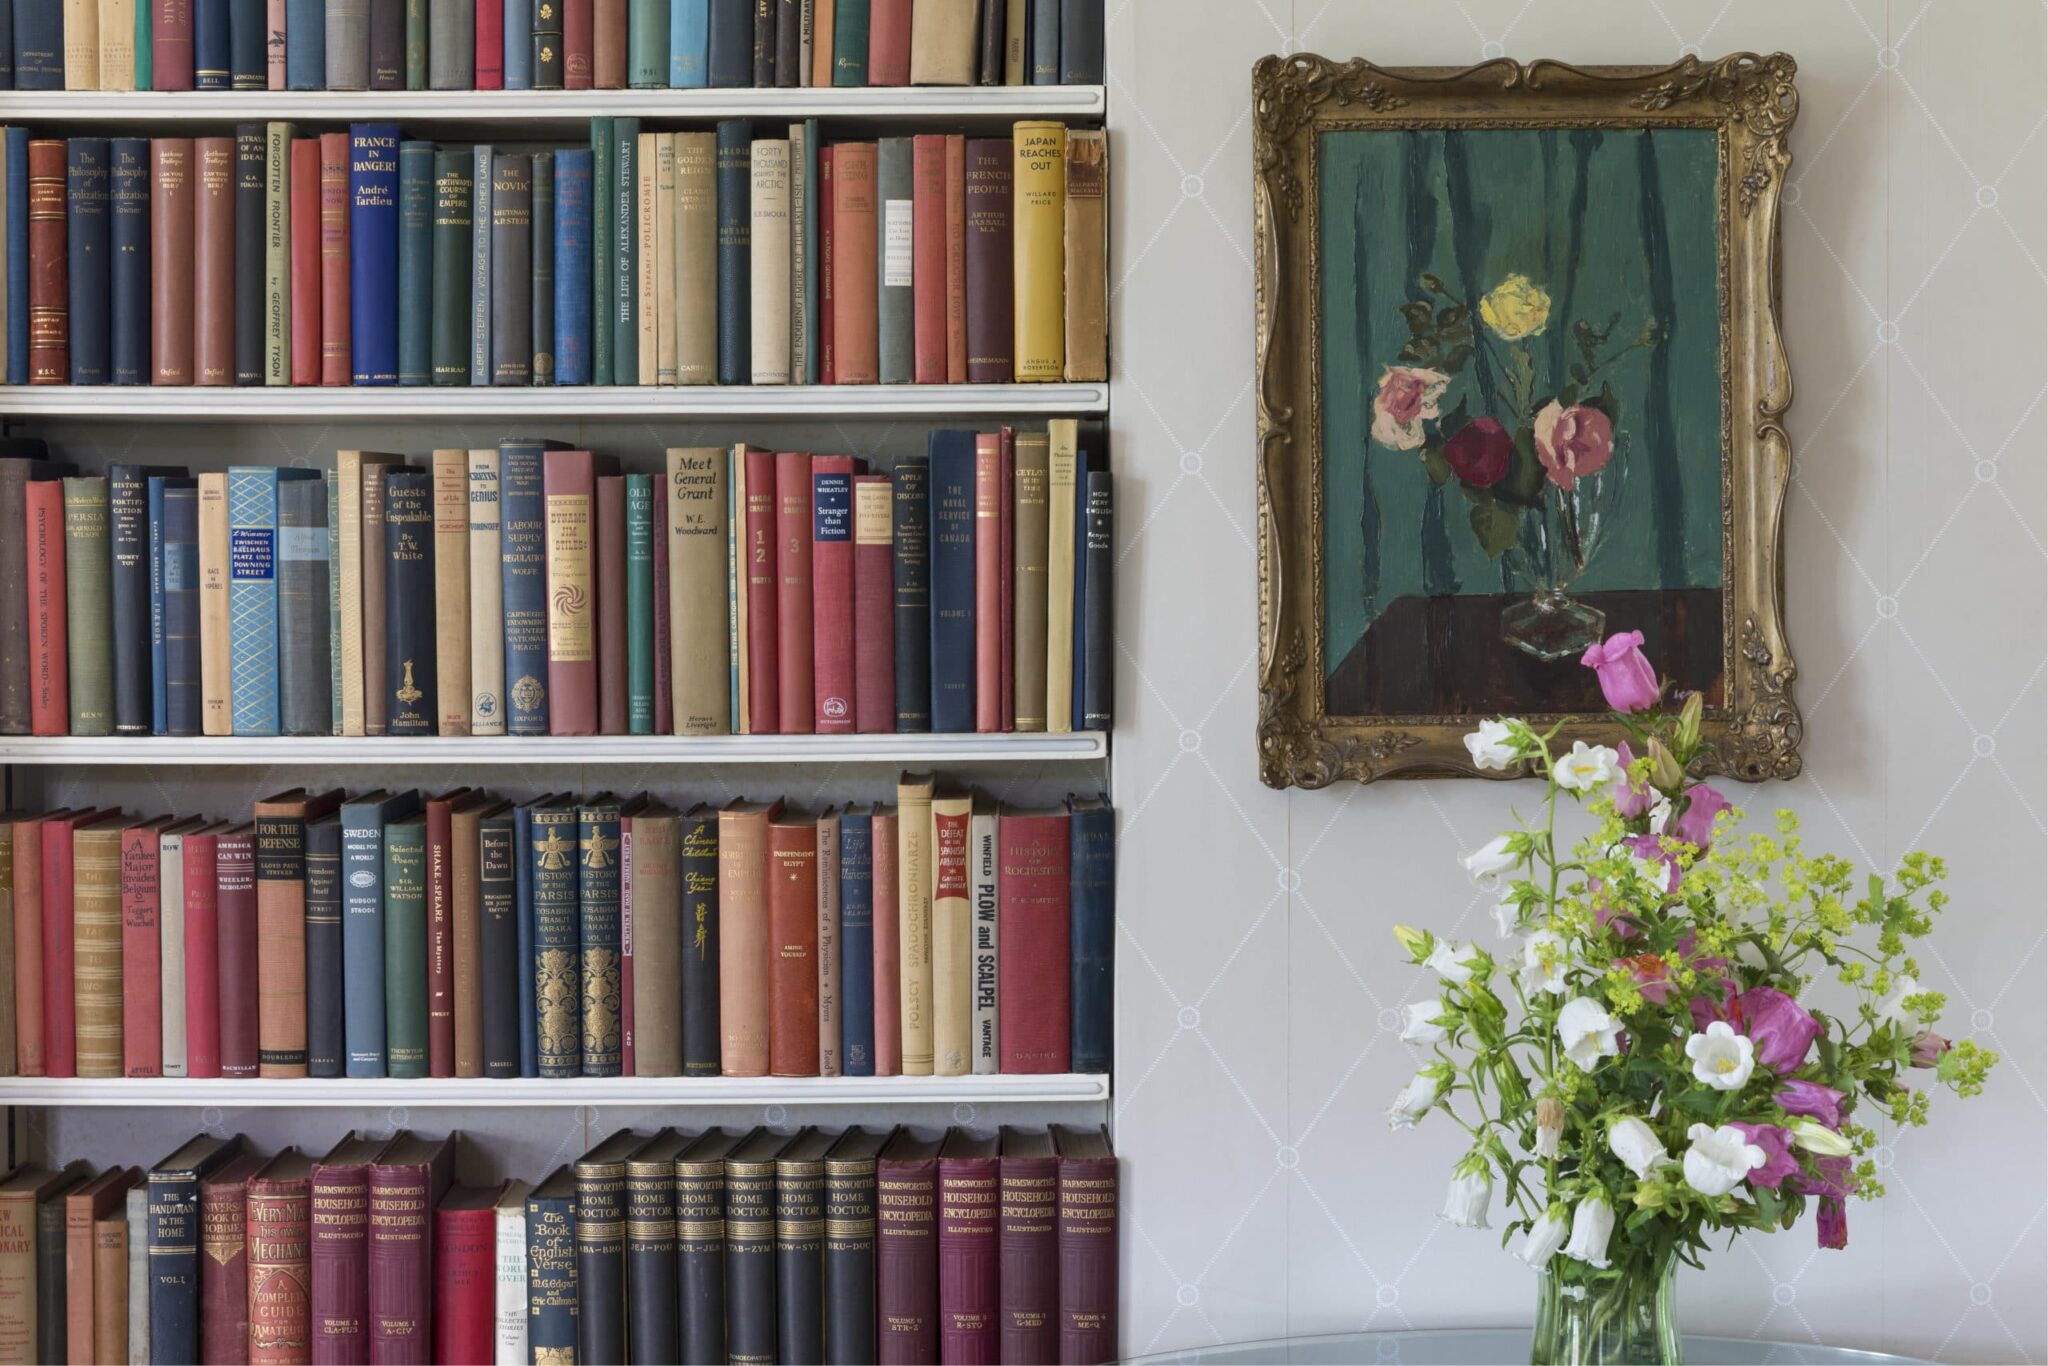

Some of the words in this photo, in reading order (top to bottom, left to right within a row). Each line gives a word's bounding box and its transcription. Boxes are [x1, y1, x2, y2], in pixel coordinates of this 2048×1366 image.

[803, 0, 811, 34] MILITAR
[354, 138, 395, 148] FRANCE
[1025, 138, 1056, 146] JAPAN
[757, 147, 782, 157] FORTY
[80, 153, 94, 164] The
[121, 153, 135, 164] The
[622, 141, 630, 185] STEWART
[354, 162, 396, 172] DANGER!
[753, 159, 787, 169] THOUSAND
[1031, 162, 1051, 170] OUT
[967, 172, 1011, 180] FRENCH
[83, 178, 92, 188] of
[124, 178, 131, 188] of
[756, 180, 783, 189] ARCTIC
[358, 186, 388, 195] André
[968, 185, 1007, 193] PEOPLE
[356, 196, 392, 206] Tardieu
[479, 235, 486, 248] TO
[622, 258, 628, 270] OF
[272, 277, 278, 286] by
[680, 458, 712, 470] Meet
[674, 472, 716, 484] General
[389, 486, 426, 497] Guests
[471, 492, 497, 501] GENIUS
[630, 488, 650, 497] OLD
[677, 487, 712, 500] Grant
[393, 501, 402, 509] of
[409, 501, 421, 509] the
[630, 501, 650, 510] AGE
[386, 511, 431, 522] Unspeakable
[819, 507, 848, 516] Stranger
[676, 527, 717, 535] Woodward
[402, 534, 412, 543] By
[508, 534, 542, 542] SUPPLY
[757, 530, 763, 544] 1
[790, 539, 800, 551] 3
[756, 550, 766, 562] 2
[260, 824, 276, 834] FOR
[280, 824, 299, 834] THE
[344, 830, 380, 838] SWEDEN
[696, 825, 703, 834] A
[941, 830, 963, 838] DEFEAT
[684, 835, 716, 845] Chinese
[822, 828, 832, 846] The
[132, 839, 142, 850] A
[260, 838, 300, 848] DEFENSE
[484, 840, 508, 848] Before
[846, 839, 864, 851] Life
[124, 850, 155, 860] Yankee
[983, 835, 992, 876] WINFIELD
[125, 862, 153, 872] Major
[433, 844, 442, 922] SHAKE-SPEARE
[536, 891, 574, 899] PARSIS
[910, 831, 920, 968] SPADOCHRONIARZE
[979, 884, 994, 921] PLOW
[823, 913, 830, 924] of
[978, 927, 994, 950] and
[823, 936, 832, 975] Physician
[978, 955, 994, 1011] SCALPEL
[823, 996, 832, 1022] Myers
[910, 980, 919, 1029] POLSCY
[982, 1019, 991, 1057] VANTAGE
[824, 1050, 832, 1070] Reed
[1003, 1177, 1055, 1186] HARMSWORTH'S
[1063, 1178, 1114, 1188] HARMSWORTH'S
[583, 1196, 613, 1205] HOME
[634, 1194, 665, 1203] HOME
[682, 1194, 713, 1203] HOME
[732, 1195, 762, 1203] HOME
[782, 1194, 812, 1203] HOME
[833, 1193, 863, 1202] HOME
[879, 1196, 932, 1204] HOUSEHOLD
[944, 1194, 996, 1203] HOUSEHOLD
[1003, 1192, 1055, 1201] HOUSEHOLD
[1063, 1193, 1114, 1202] HOUSEHOLD
[151, 1204, 193, 1214] HANDYMAN
[314, 1200, 367, 1208] HOUSEHOLD
[372, 1201, 424, 1209] HOUSEHOLD
[578, 1208, 620, 1217] DOCTOR
[629, 1207, 672, 1216] DOCTOR
[678, 1207, 720, 1216] DOCTOR
[728, 1207, 768, 1216] DOCTOR
[778, 1207, 819, 1215] DOCTOR
[828, 1206, 870, 1214] DOCTOR
[944, 1209, 996, 1218] ENCYCLOPEDIA
[1003, 1207, 1056, 1217] ENCYCLOPEDIA
[1063, 1208, 1115, 1218] ENCYCLOPEDIA
[314, 1215, 368, 1224] ENCYCLOPEDIA
[372, 1216, 425, 1225] ENCYCLOPEDIA
[544, 1212, 563, 1222] The
[879, 1212, 933, 1220] ENCYCLOPEDIA
[158, 1228, 184, 1237] HOME
[536, 1225, 569, 1235] Book
[547, 1237, 560, 1247] of
[530, 1246, 575, 1258] English
[534, 1258, 572, 1270] Verse
[278, 1280, 285, 1289] A
[261, 1307, 302, 1316] GUIDE
